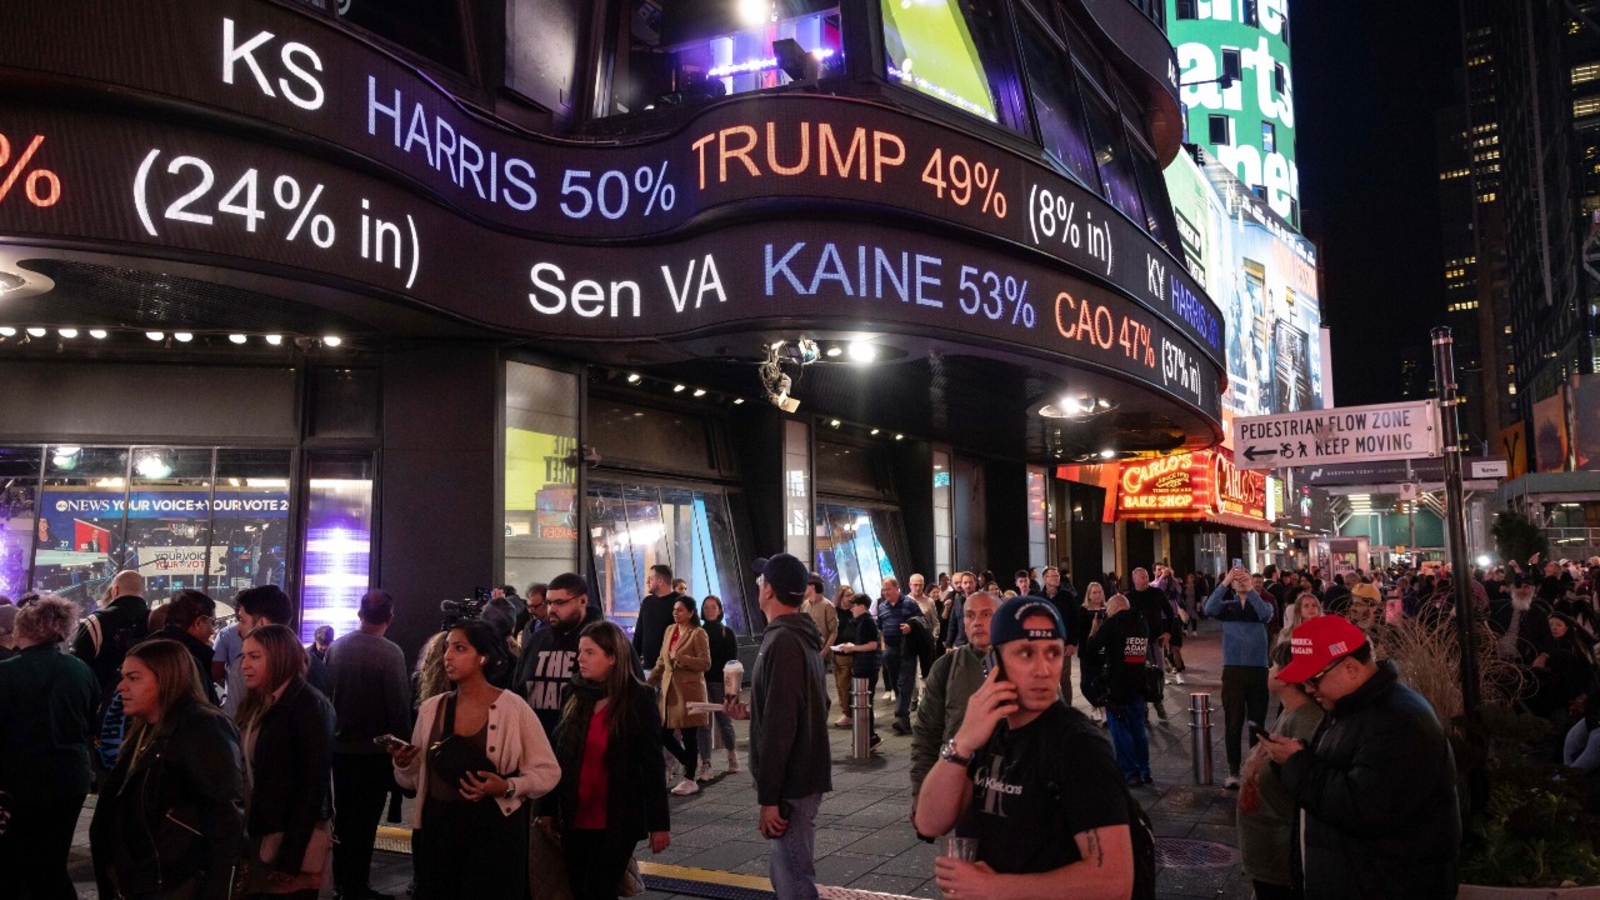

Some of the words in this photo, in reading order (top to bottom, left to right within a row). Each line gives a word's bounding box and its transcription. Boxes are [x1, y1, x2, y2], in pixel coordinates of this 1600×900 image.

[222, 17, 326, 111] KS
[367, 75, 538, 211] HARRIS
[560, 160, 676, 220] 50%
[692, 121, 906, 190] TRUMP
[922, 147, 1007, 219] 49%
[1029, 184, 1080, 249] (8%
[1086, 211, 1114, 276] in)
[1147, 253, 1165, 301] KY
[1170, 275, 1207, 338] HARRIS
[133, 148, 336, 249] (24%
[361, 198, 420, 289] in)
[529, 261, 641, 318] Sen
[661, 254, 728, 314] VA
[765, 241, 944, 309] KAINE
[959, 264, 1037, 329] 53%
[1055, 292, 1115, 350] CAO
[1119, 315, 1156, 369] 47%
[1161, 337, 1189, 390] (37%
[1189, 357, 1201, 406] in)
[1241, 417, 1323, 440] PEDESTRIAN
[1329, 413, 1368, 432] FLOW
[1372, 410, 1411, 430] ZONE
[1315, 438, 1350, 456] KEEP
[1356, 433, 1413, 454] MOVING
[1123, 453, 1193, 493] CARLO'S
[67, 500, 110, 511] NEWS
[113, 500, 152, 511] YOUR
[152, 500, 194, 511] VOICE
[243, 500, 279, 511] VOTE
[1124, 495, 1157, 508] BAKE
[1158, 495, 1193, 508] SHOP
[155, 553, 181, 561] YOUR
[183, 552, 206, 560] VOIC
[1029, 630, 1052, 638] 2024
[1291, 638, 1313, 646] MERICA
[535, 650, 577, 678] THE
